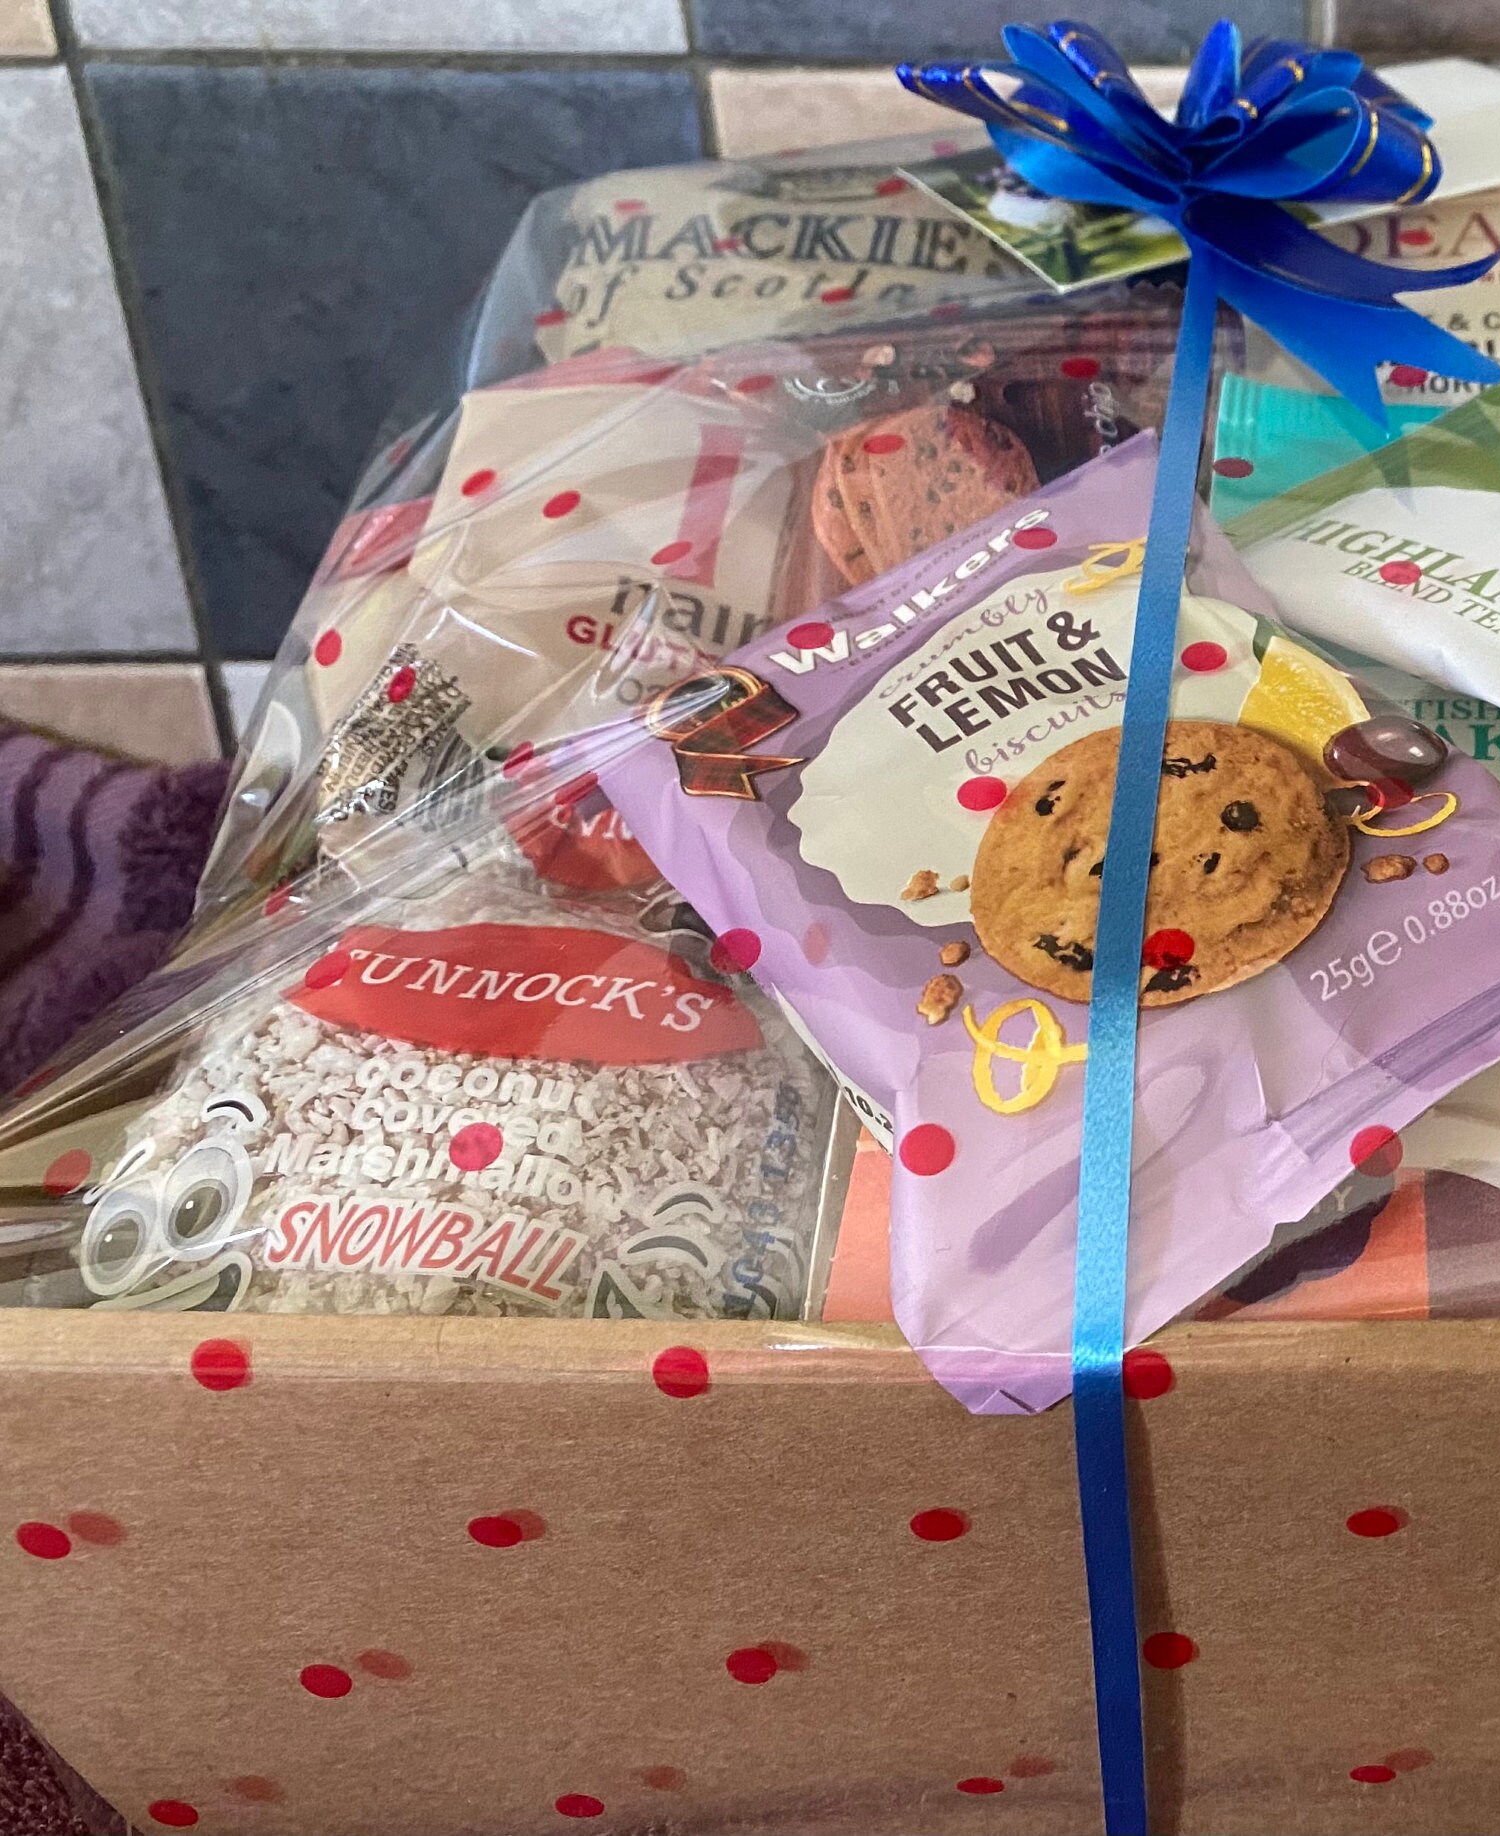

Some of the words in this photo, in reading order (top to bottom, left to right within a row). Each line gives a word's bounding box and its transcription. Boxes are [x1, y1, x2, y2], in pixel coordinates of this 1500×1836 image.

[572, 213, 1003, 278] MACKIE
[769, 508, 1051, 675] Walkers
[879, 586, 1050, 699] crumbly
[888, 628, 1047, 728] FRUIT
[1046, 610, 1101, 651] &
[916, 647, 1128, 754] LEMON
[965, 690, 1127, 775] biscuits
[267, 1201, 579, 1301] SNOWBALL
